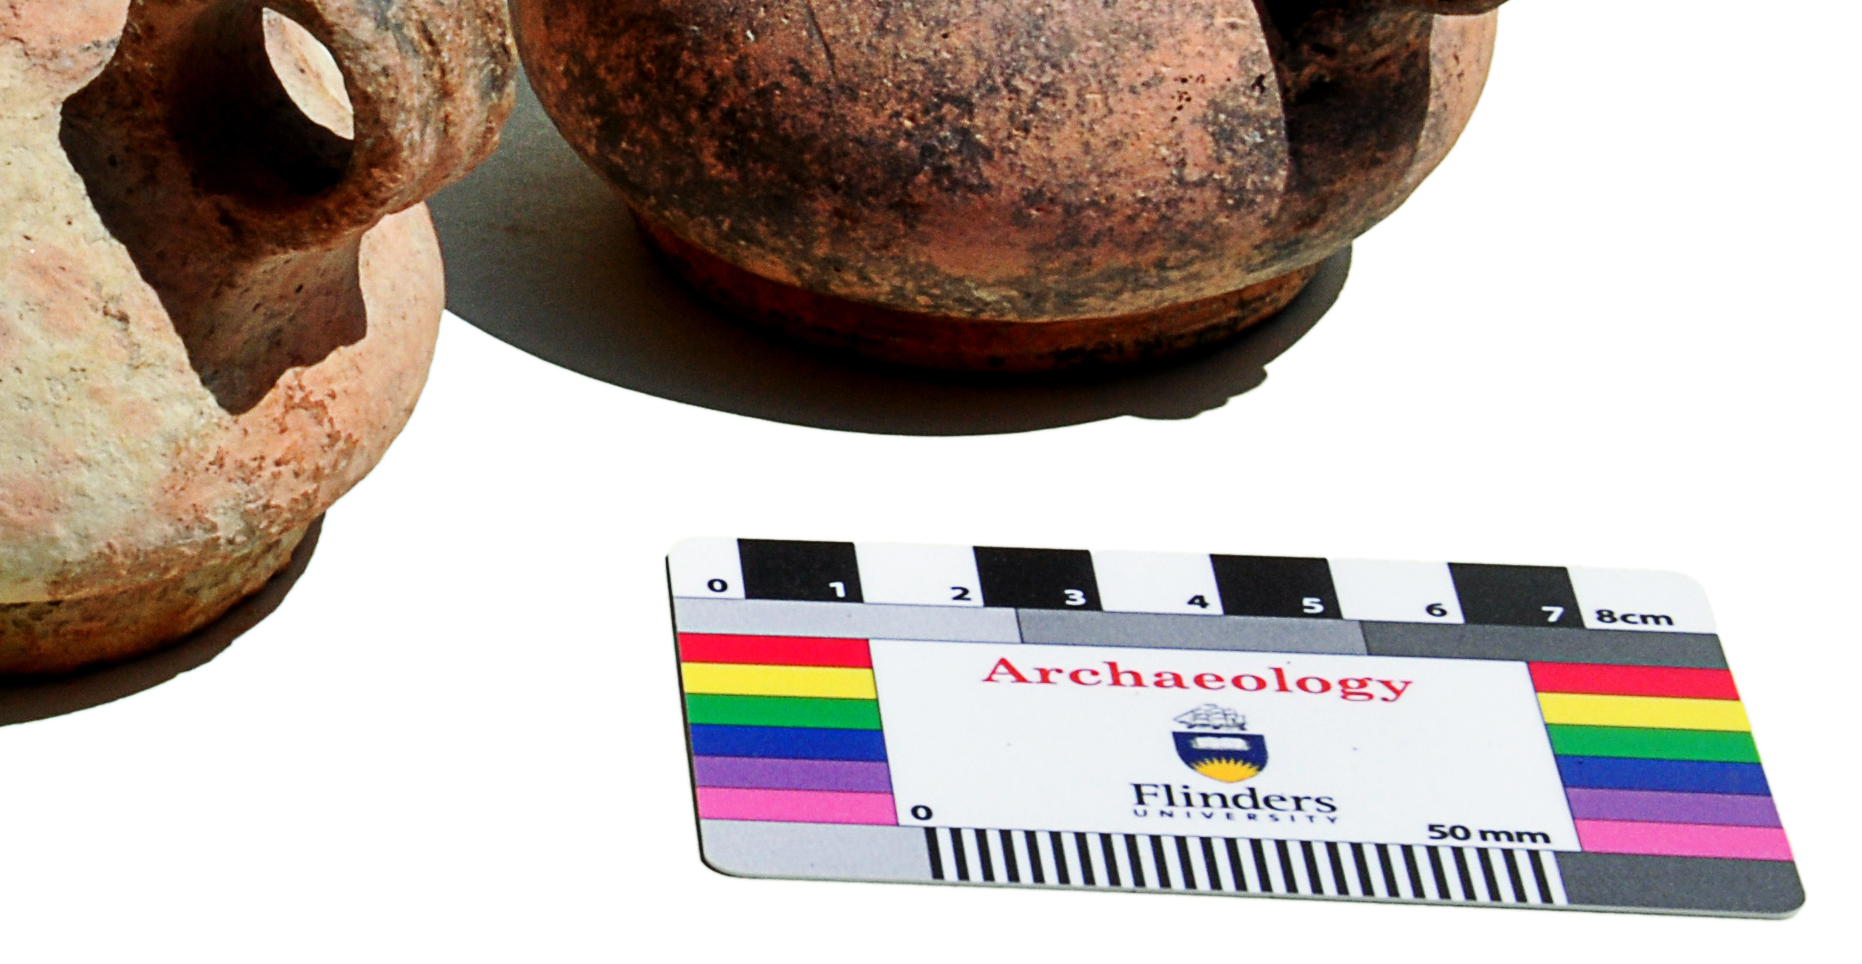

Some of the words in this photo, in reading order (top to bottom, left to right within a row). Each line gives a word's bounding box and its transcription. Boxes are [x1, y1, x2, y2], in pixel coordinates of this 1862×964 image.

[707, 578, 729, 593] 0
[828, 581, 846, 598] 1
[950, 586, 972, 602] 2
[1063, 588, 1087, 606] 3
[1187, 594, 1210, 609] 4
[1302, 597, 1325, 614] 5
[1425, 602, 1448, 618] 6
[1541, 605, 1564, 623] 7
[1595, 609, 1674, 626] 8cm
[982, 657, 1413, 702] Archaeology
[1132, 783, 1338, 813] Flinders
[910, 804, 933, 821] 0
[1134, 809, 1339, 824] UNIVERSITY
[1428, 824, 1472, 841] 50
[1478, 829, 1552, 844] mm
